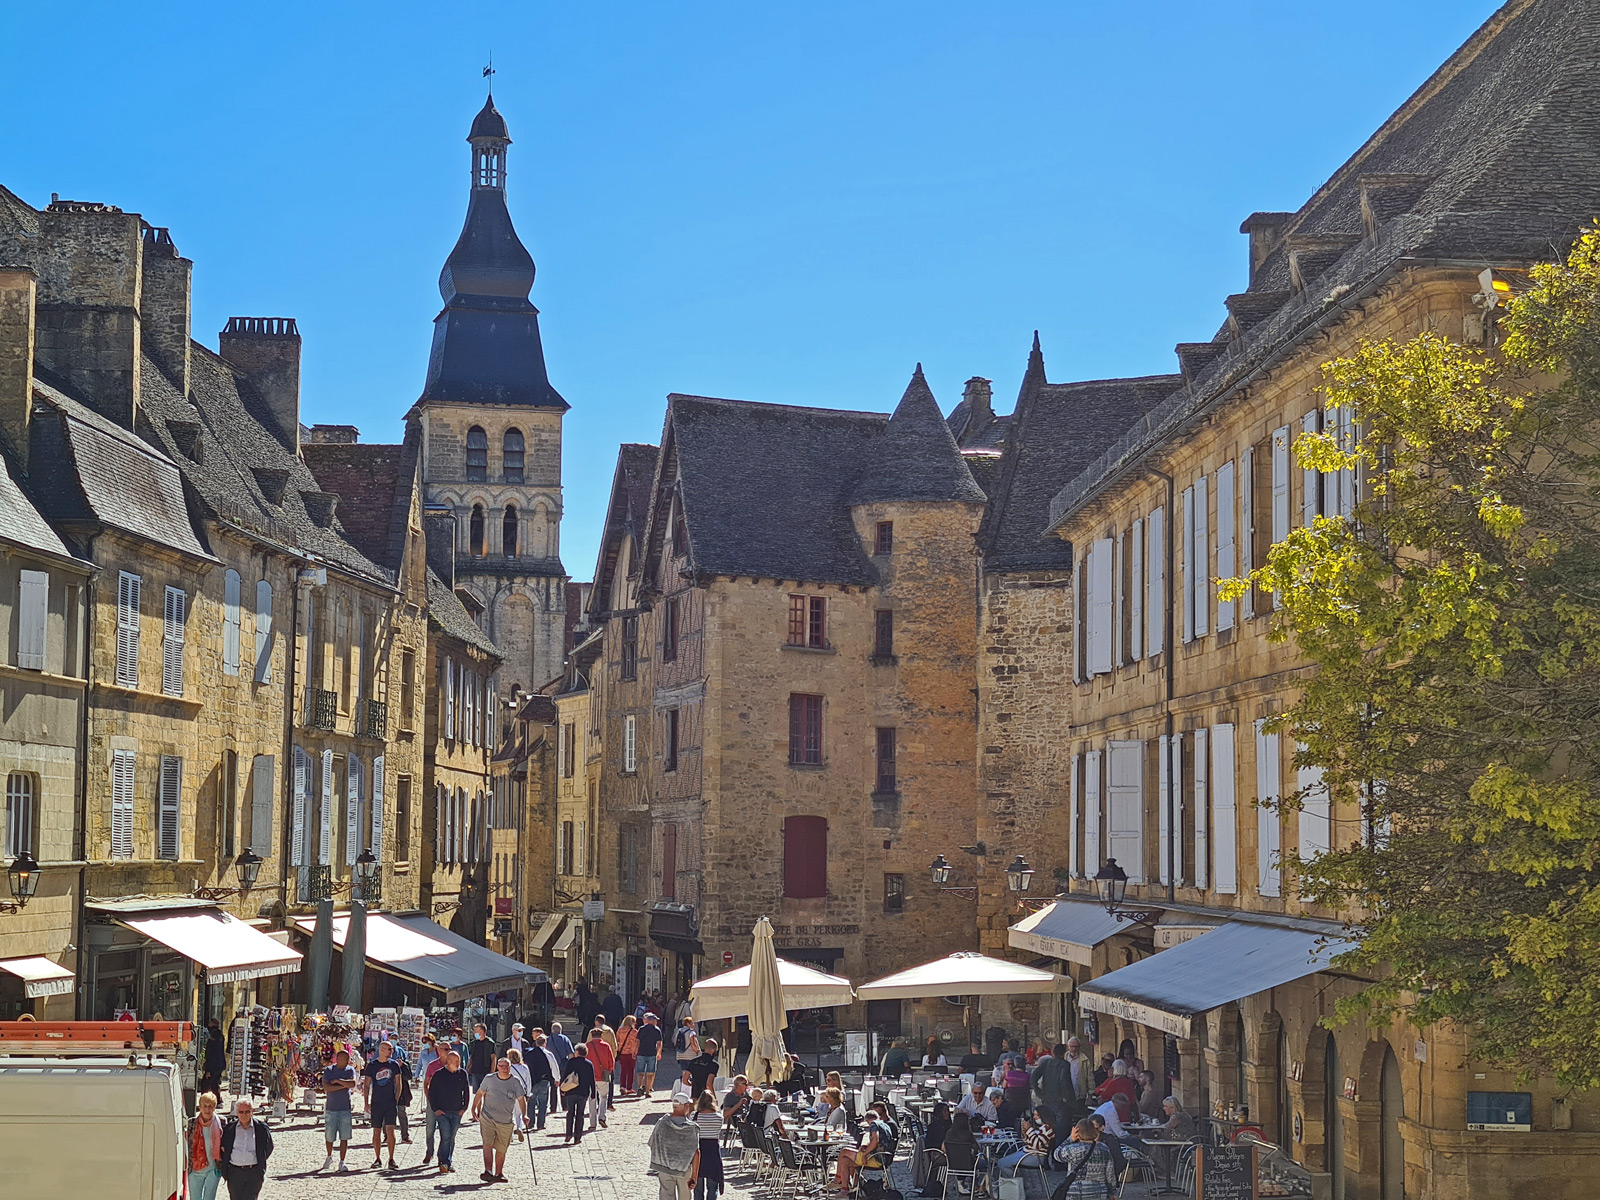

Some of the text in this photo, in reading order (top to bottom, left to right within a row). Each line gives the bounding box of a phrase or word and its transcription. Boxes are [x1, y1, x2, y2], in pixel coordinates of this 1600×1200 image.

[795, 925, 808, 935] DU
[814, 924, 859, 935] PERIGORD
[797, 937, 822, 947] GRAS
